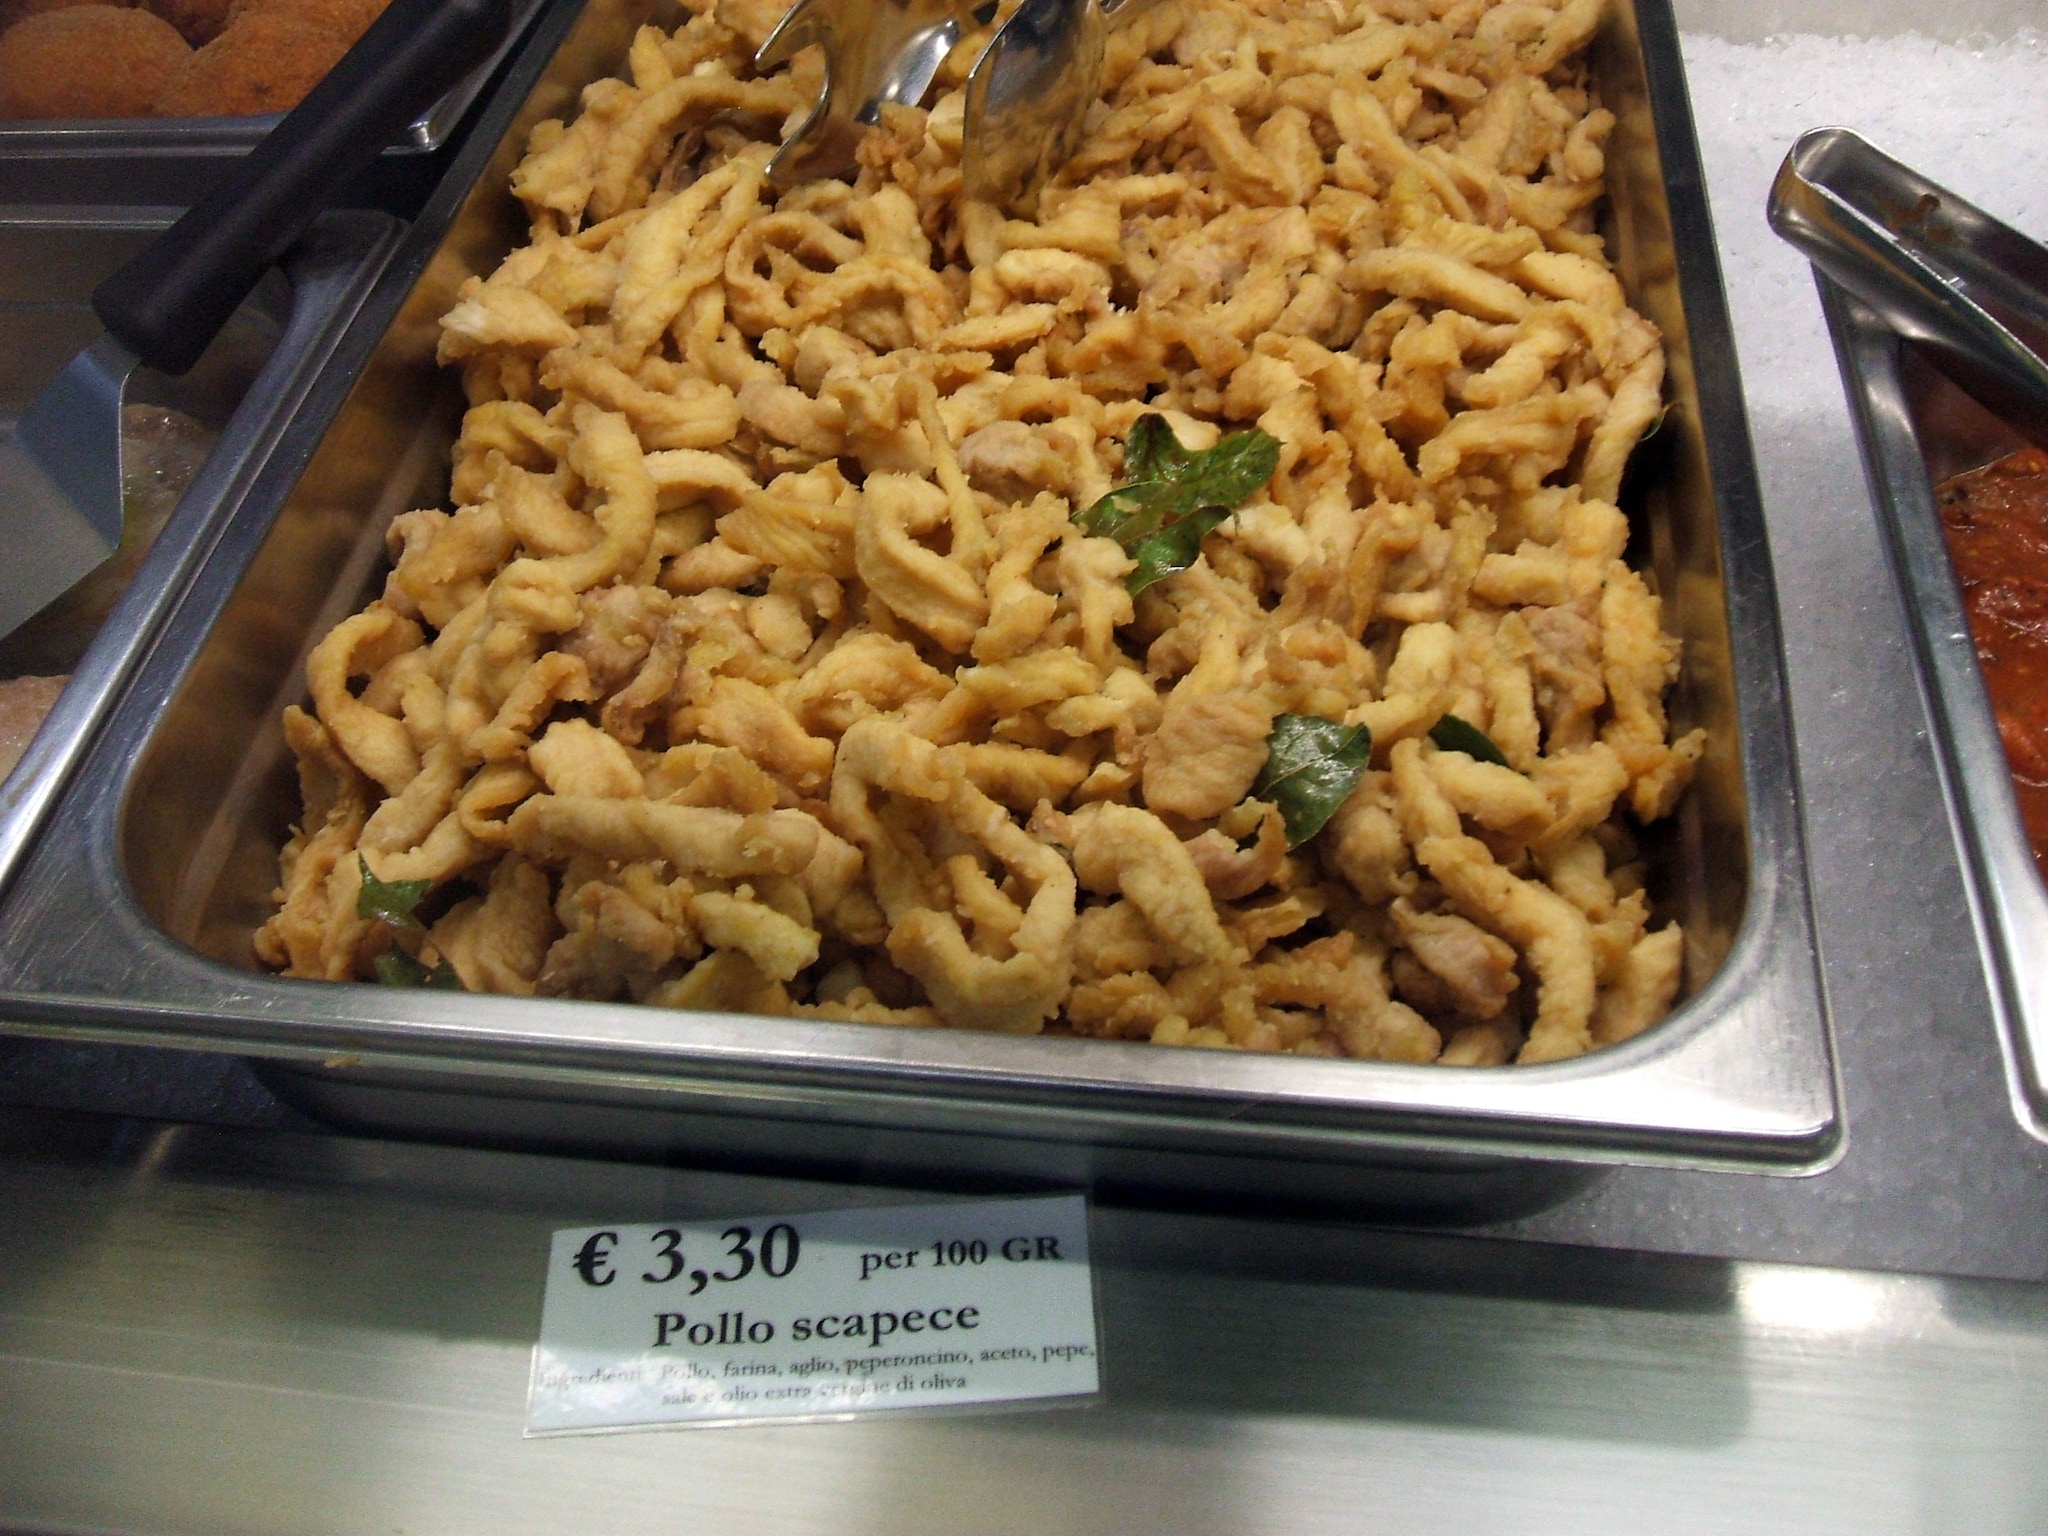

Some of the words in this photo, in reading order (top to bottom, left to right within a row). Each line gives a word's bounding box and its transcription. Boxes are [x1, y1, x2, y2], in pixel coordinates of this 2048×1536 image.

[573, 1232, 617, 1287] €
[642, 1223, 799, 1296] 3,30
[859, 1252, 918, 1280] per
[932, 1239, 988, 1266] 100
[1002, 1235, 1064, 1262] GR
[652, 1312, 774, 1347] Pollo
[791, 1304, 980, 1348] scapece
[724, 1360, 783, 1378] farina,
[789, 1356, 840, 1379] aglio,
[846, 1350, 974, 1375] peperoncino,
[980, 1347, 1036, 1363] aceto,
[721, 1384, 757, 1402] olio
[765, 1381, 812, 1401] extra
[896, 1375, 915, 1392] di
[920, 1373, 967, 1392] oliva
